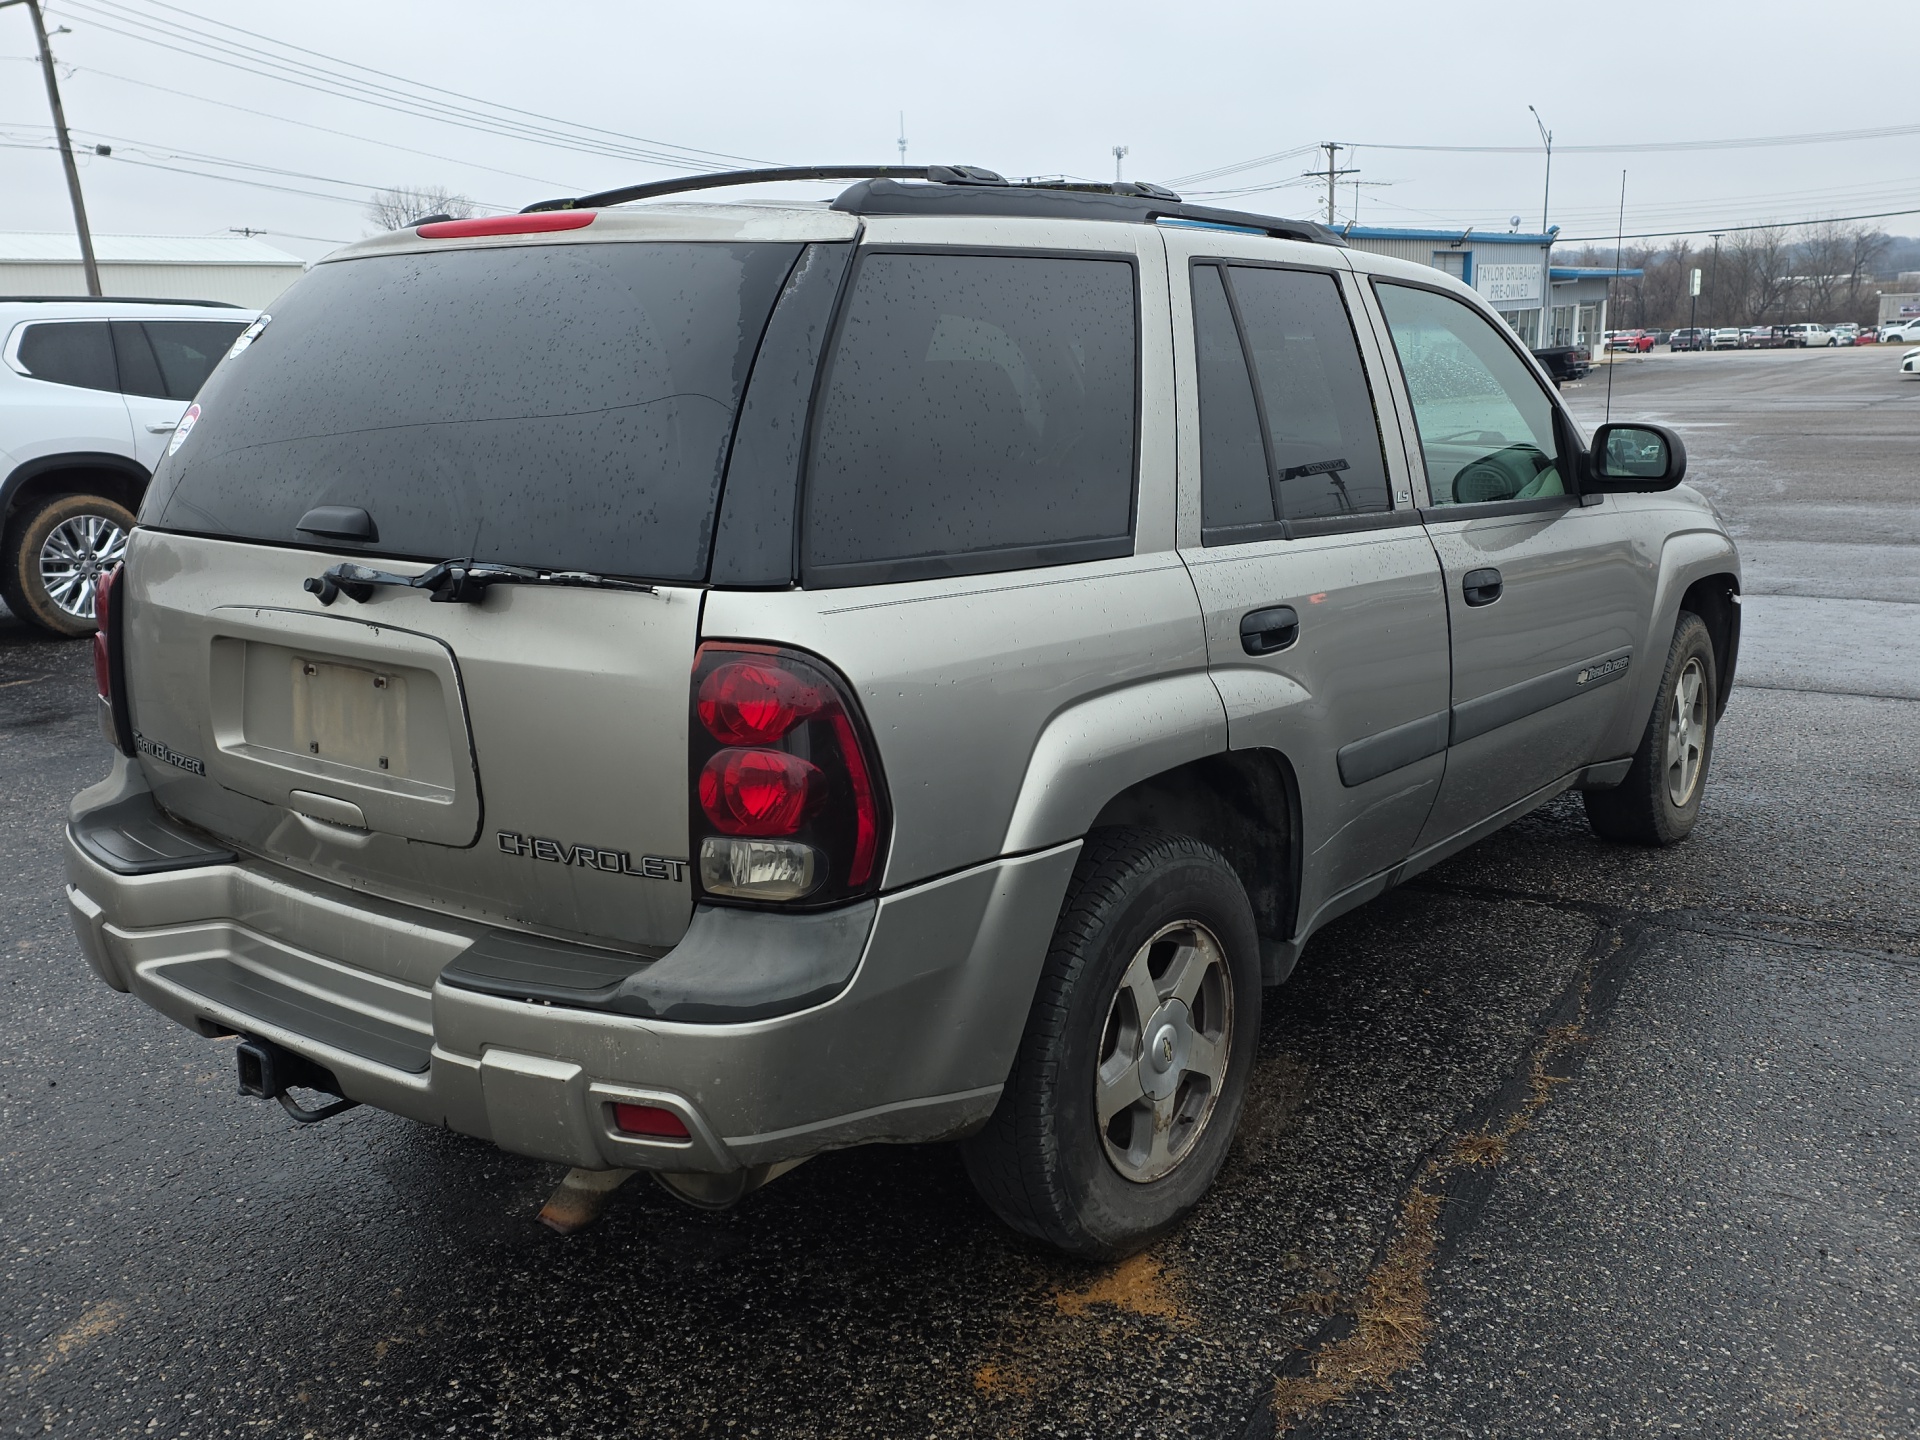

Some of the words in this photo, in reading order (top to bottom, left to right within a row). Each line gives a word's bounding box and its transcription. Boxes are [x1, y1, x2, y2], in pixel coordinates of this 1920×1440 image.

[1479, 266, 1504, 281] TAYLOR
[1506, 265, 1541, 281] GRUBAUGH
[1490, 283, 1529, 299] PRE-OWNED
[1396, 490, 1409, 503] LS
[496, 830, 688, 882] CHEVROLET
